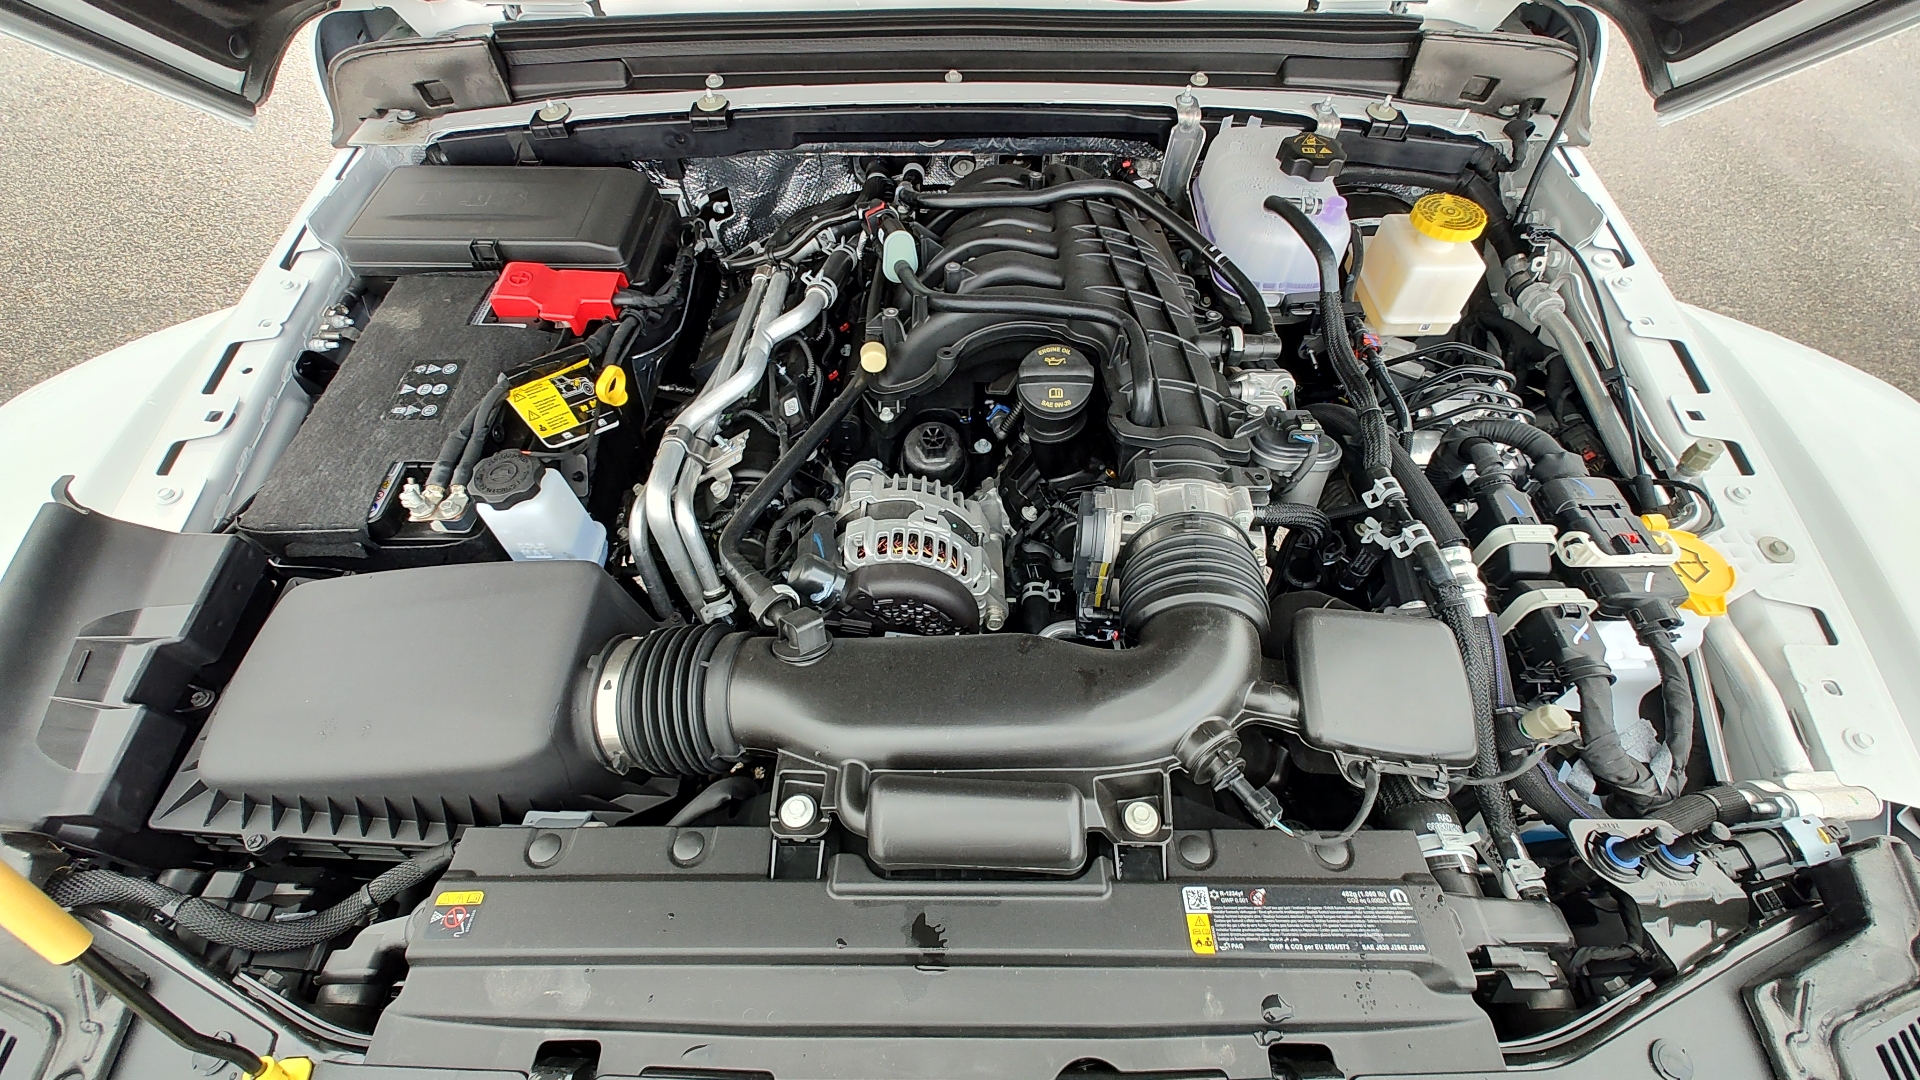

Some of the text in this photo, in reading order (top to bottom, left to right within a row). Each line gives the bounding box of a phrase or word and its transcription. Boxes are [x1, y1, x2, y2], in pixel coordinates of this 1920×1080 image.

[1038, 347, 1071, 355] ENGINE OIL
[1054, 400, 1072, 408] 0W-20
[1436, 813, 1452, 822] RAD
[1220, 890, 1244, 898] R-1234yf
